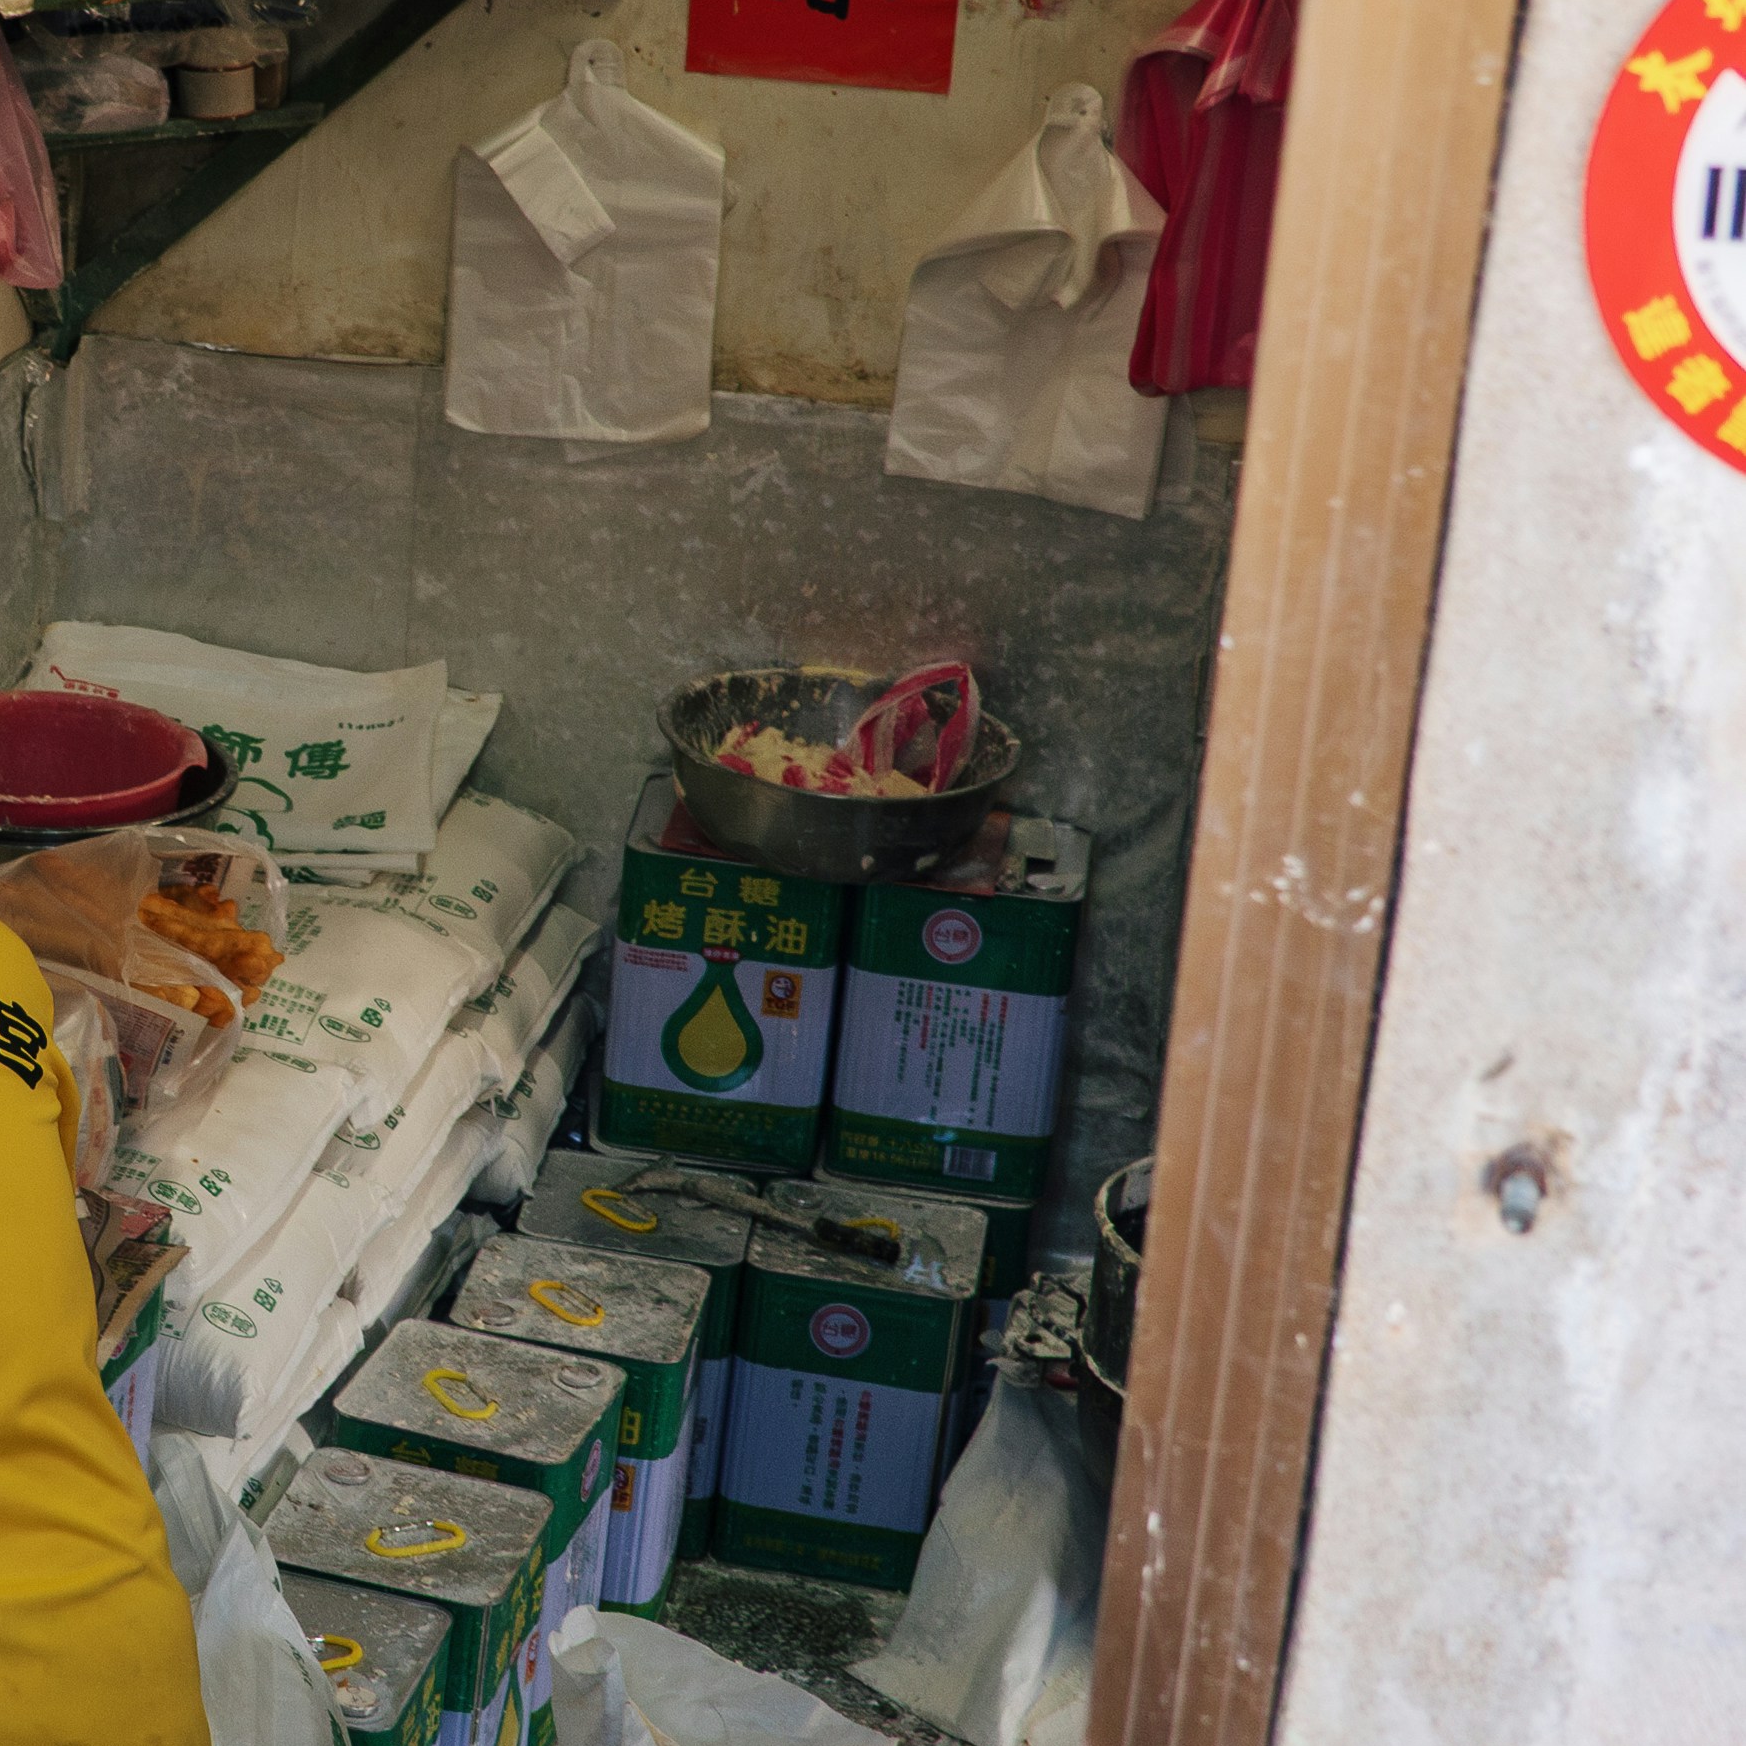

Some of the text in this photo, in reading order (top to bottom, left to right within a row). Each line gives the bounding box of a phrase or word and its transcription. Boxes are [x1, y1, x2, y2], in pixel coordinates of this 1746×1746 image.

[679, 867, 782, 907] 台糖
[642, 898, 808, 955] 烤酥油
